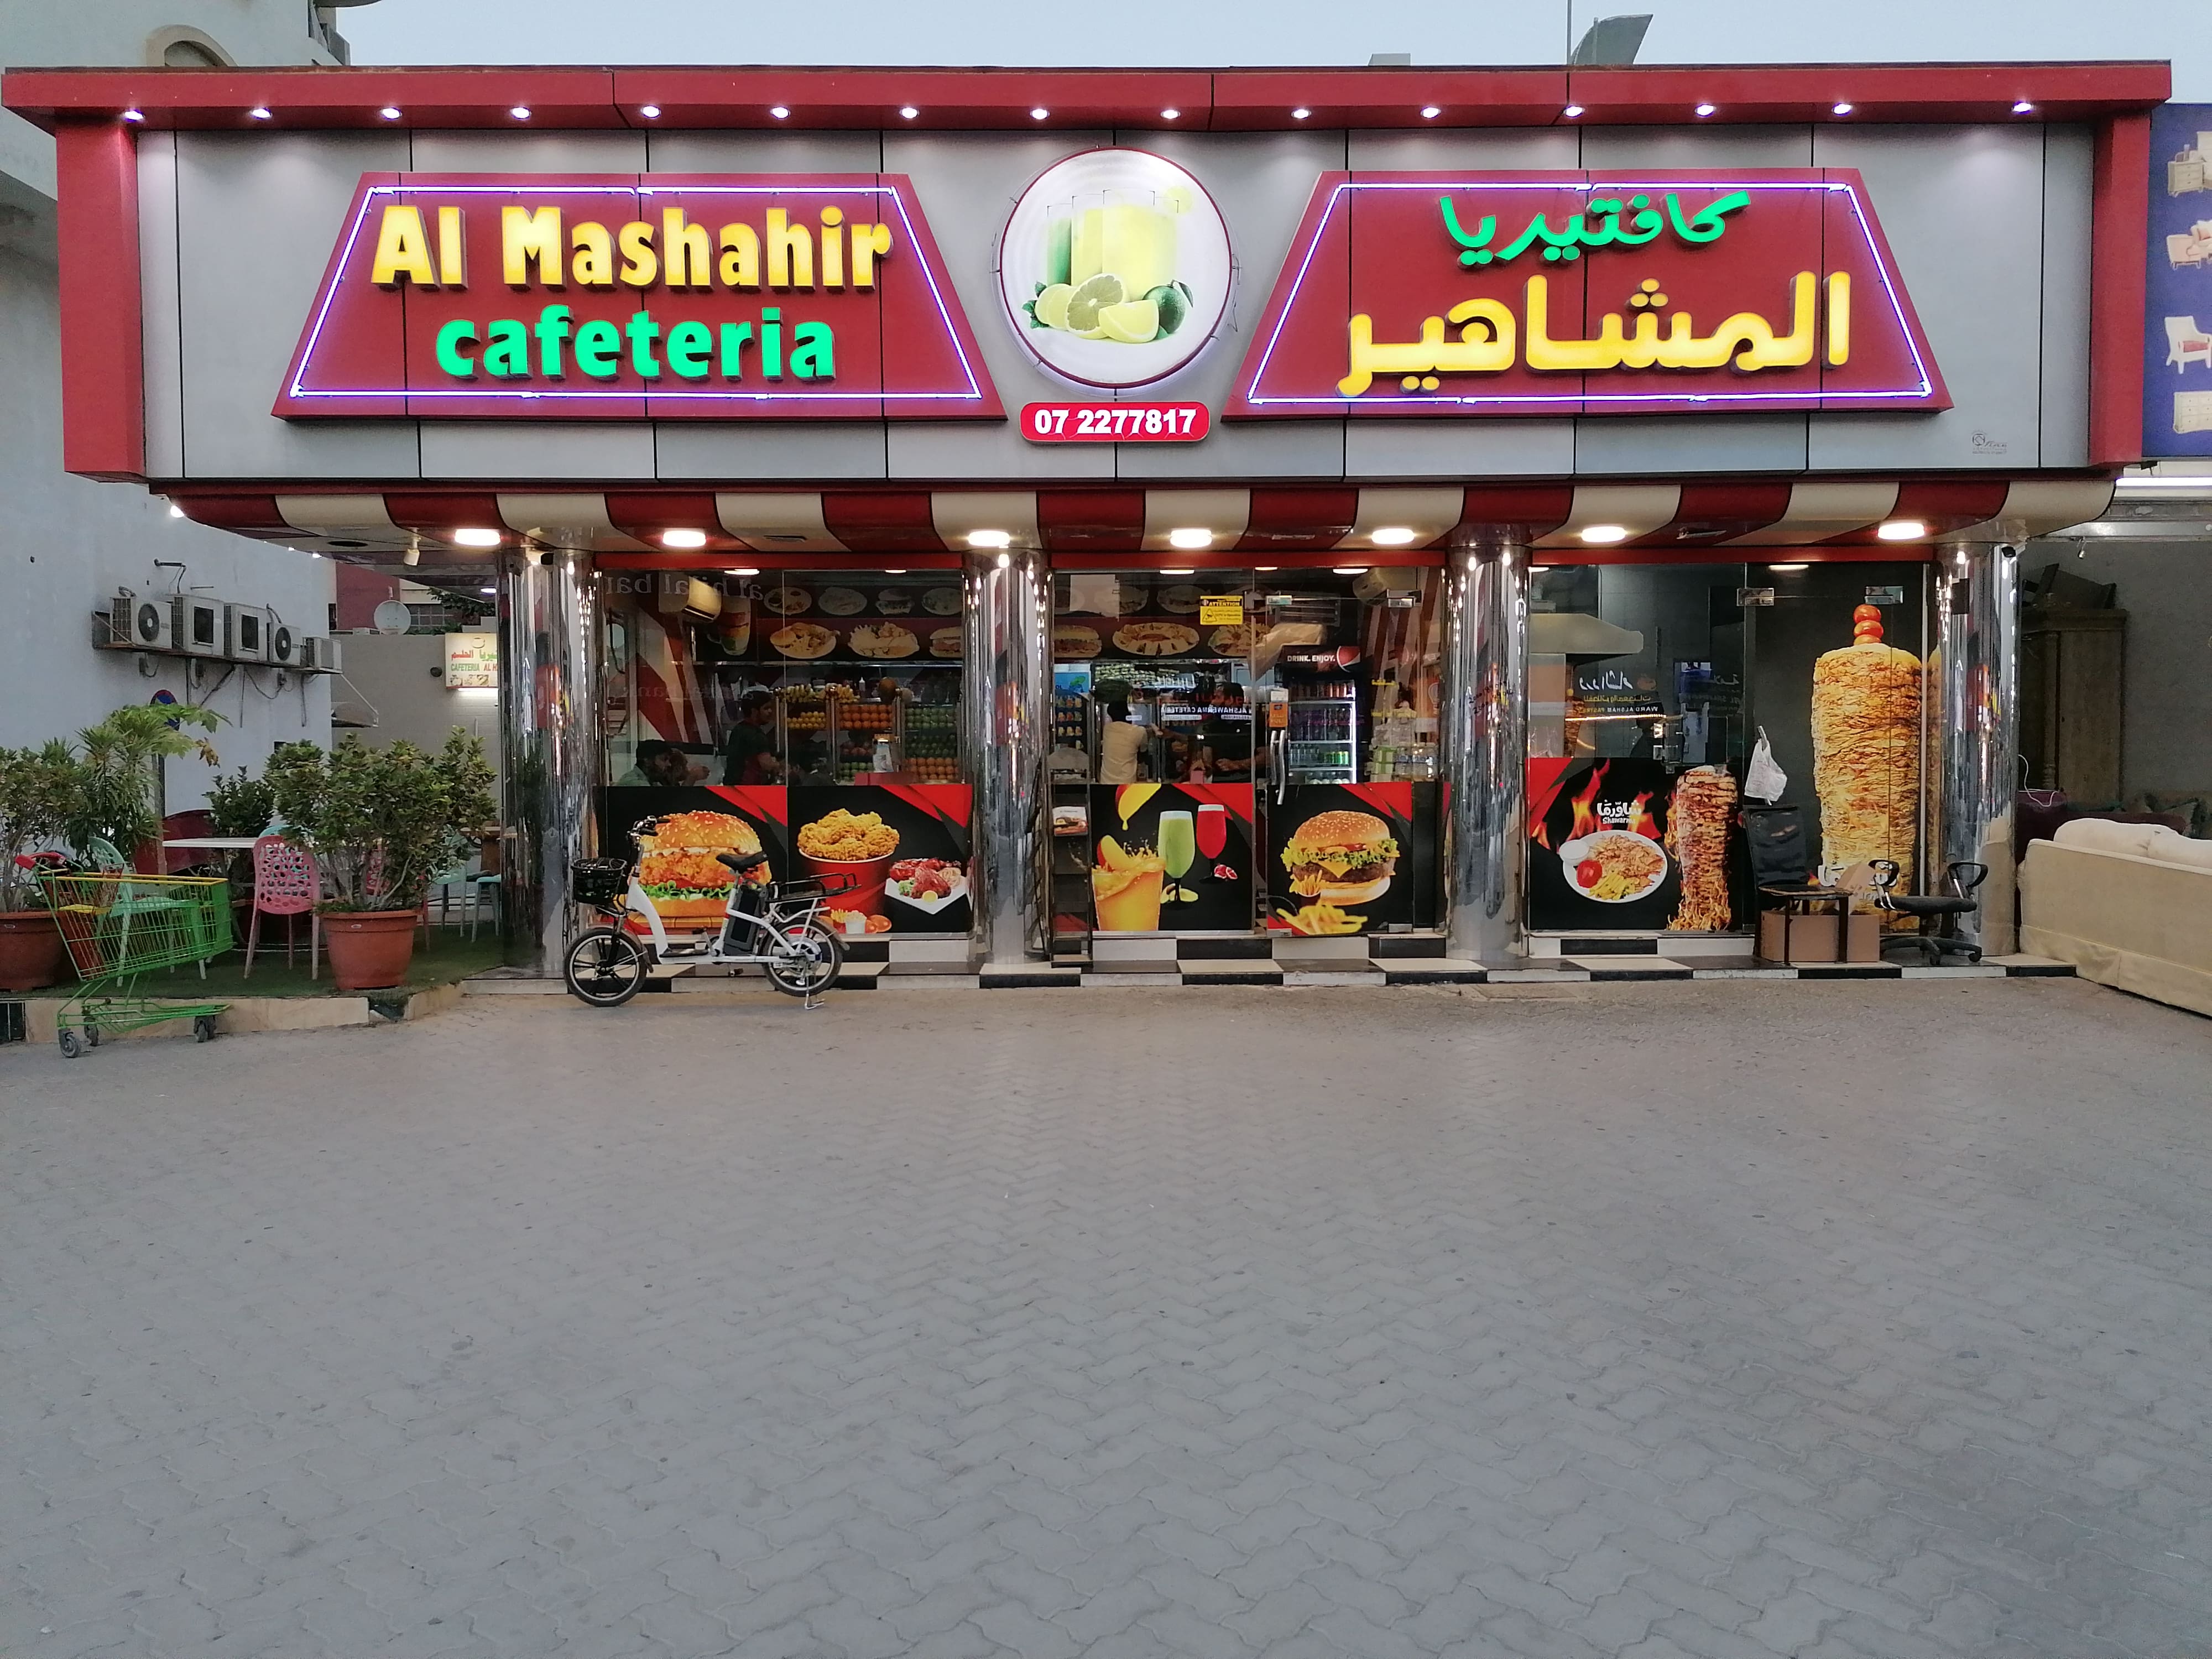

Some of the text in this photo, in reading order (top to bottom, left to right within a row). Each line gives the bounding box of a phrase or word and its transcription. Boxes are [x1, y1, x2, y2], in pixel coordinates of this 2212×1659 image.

[371, 204, 894, 290] Al Mashahir
[1439, 190, 1752, 267] كافتيريا
[435, 304, 837, 382] cafeteria
[1335, 270, 1851, 396] المشاهير
[1035, 408, 1197, 434] 07 2277817
[451, 663, 480, 671] CAFETERIA
[483, 663, 491, 671] AL
[1311, 655, 1335, 663] ENJOY.
